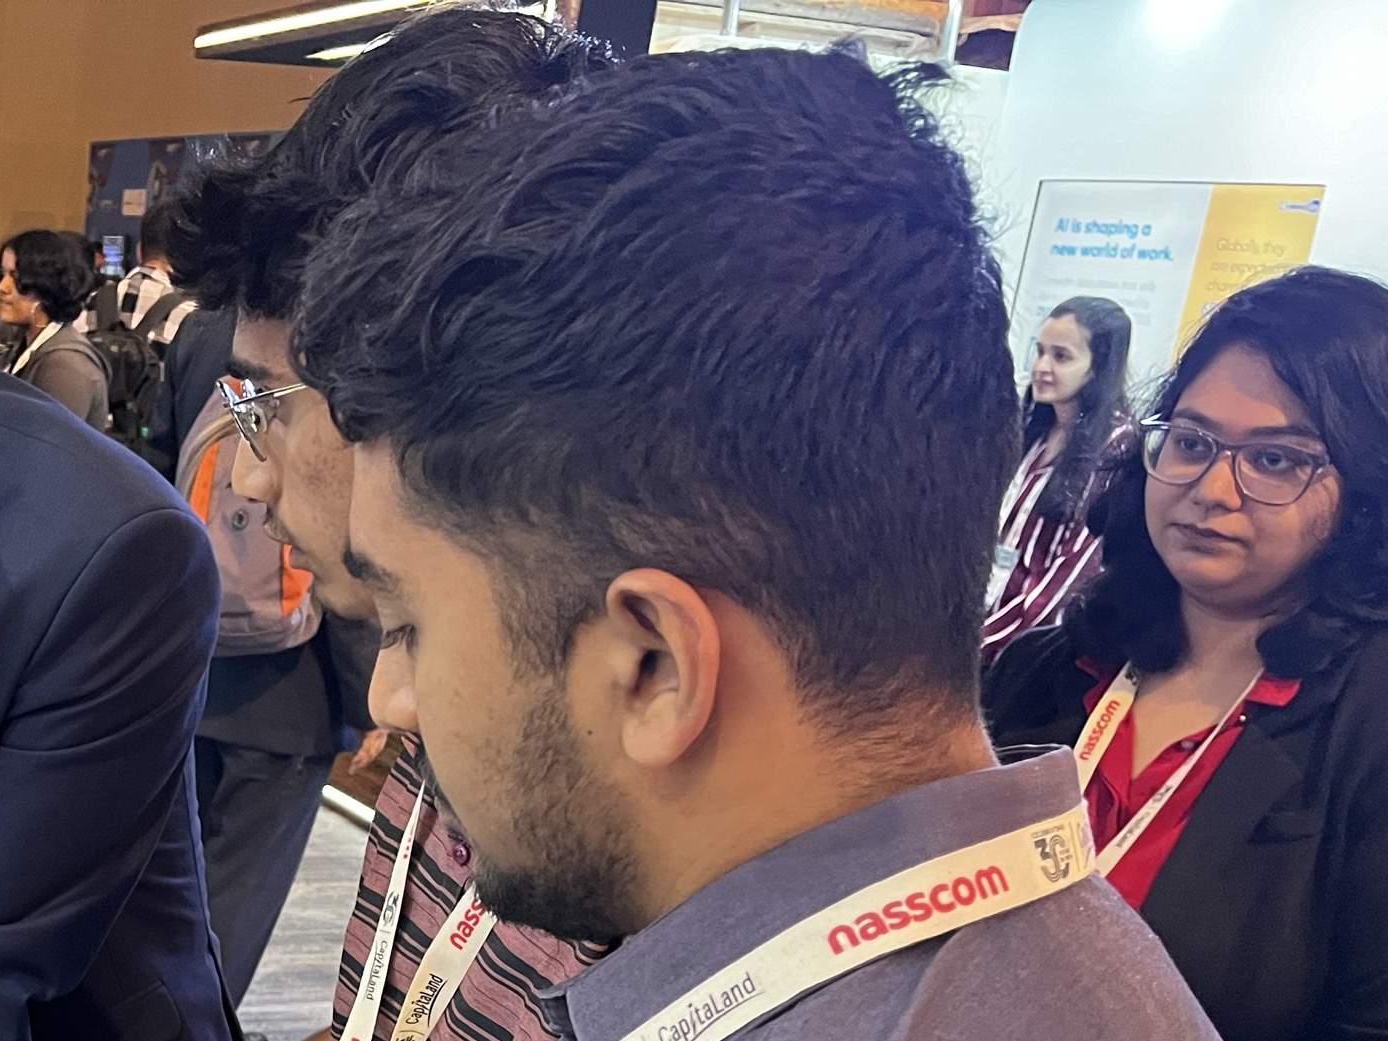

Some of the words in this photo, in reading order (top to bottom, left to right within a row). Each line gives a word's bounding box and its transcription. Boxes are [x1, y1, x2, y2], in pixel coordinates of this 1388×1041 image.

[1050, 245, 1076, 256] new
[1080, 242, 1119, 258] world
[1120, 243, 1136, 258] of
[1084, 219, 1139, 239] shaping
[1078, 699, 1121, 761] nasscom
[449, 896, 486, 951] nass
[827, 865, 1010, 955] nasscom
[365, 939, 389, 1001] CapitaLand
[405, 972, 444, 1026] CapitaLand
